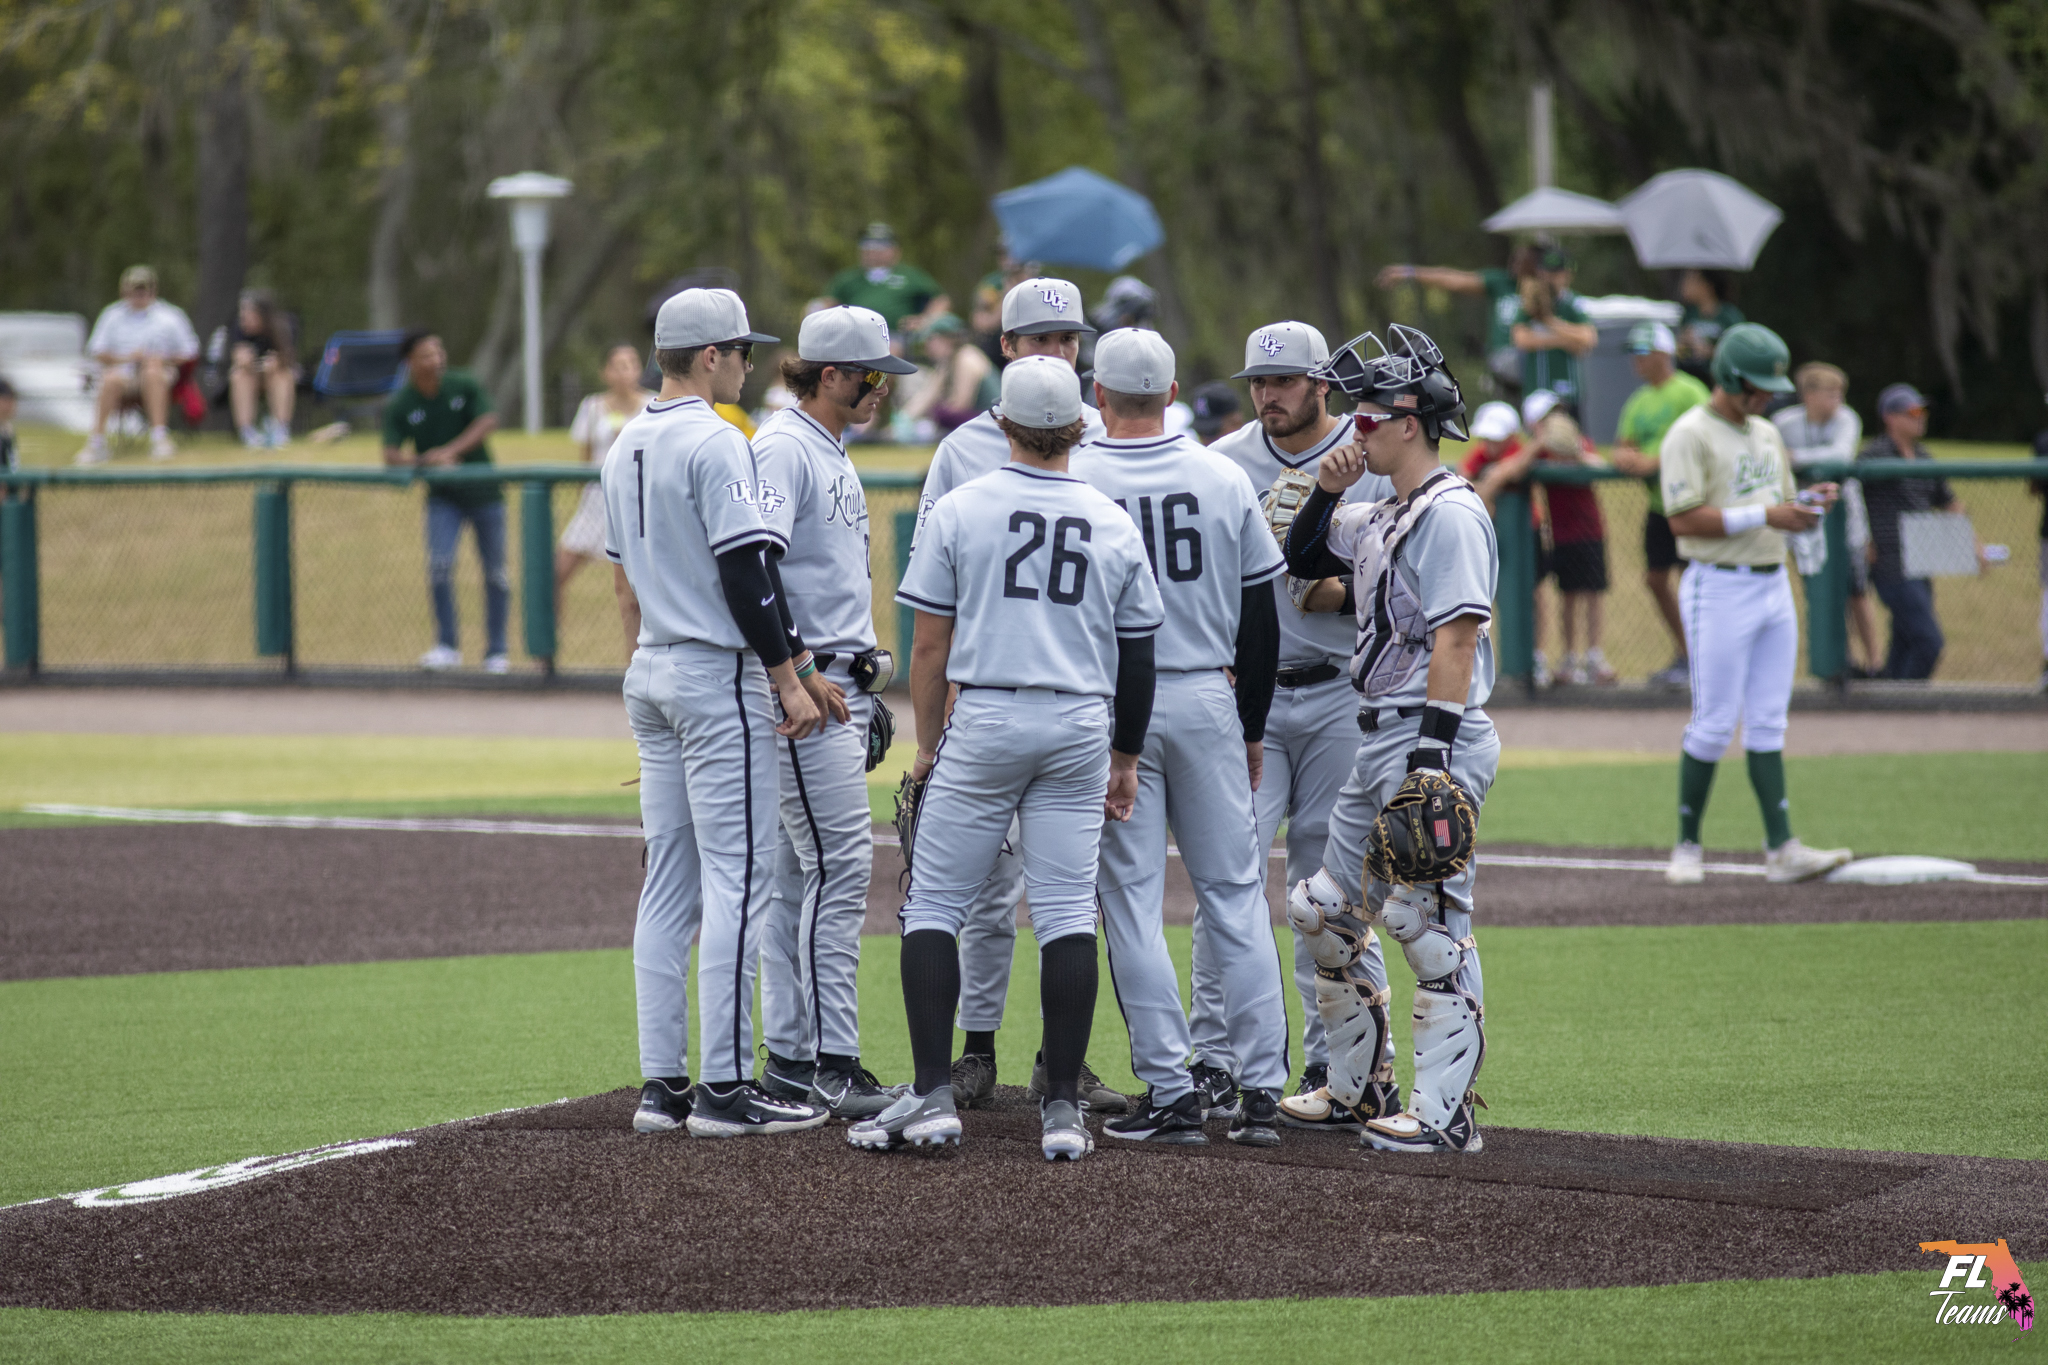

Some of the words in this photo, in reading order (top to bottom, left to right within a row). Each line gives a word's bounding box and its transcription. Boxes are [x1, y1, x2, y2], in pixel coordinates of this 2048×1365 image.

[1038, 289, 1069, 313] UCF
[1259, 333, 1285, 357] UCF
[633, 449, 645, 538] 1
[1003, 510, 1092, 606] 26
[1360, 1102, 1377, 1117] UCF
